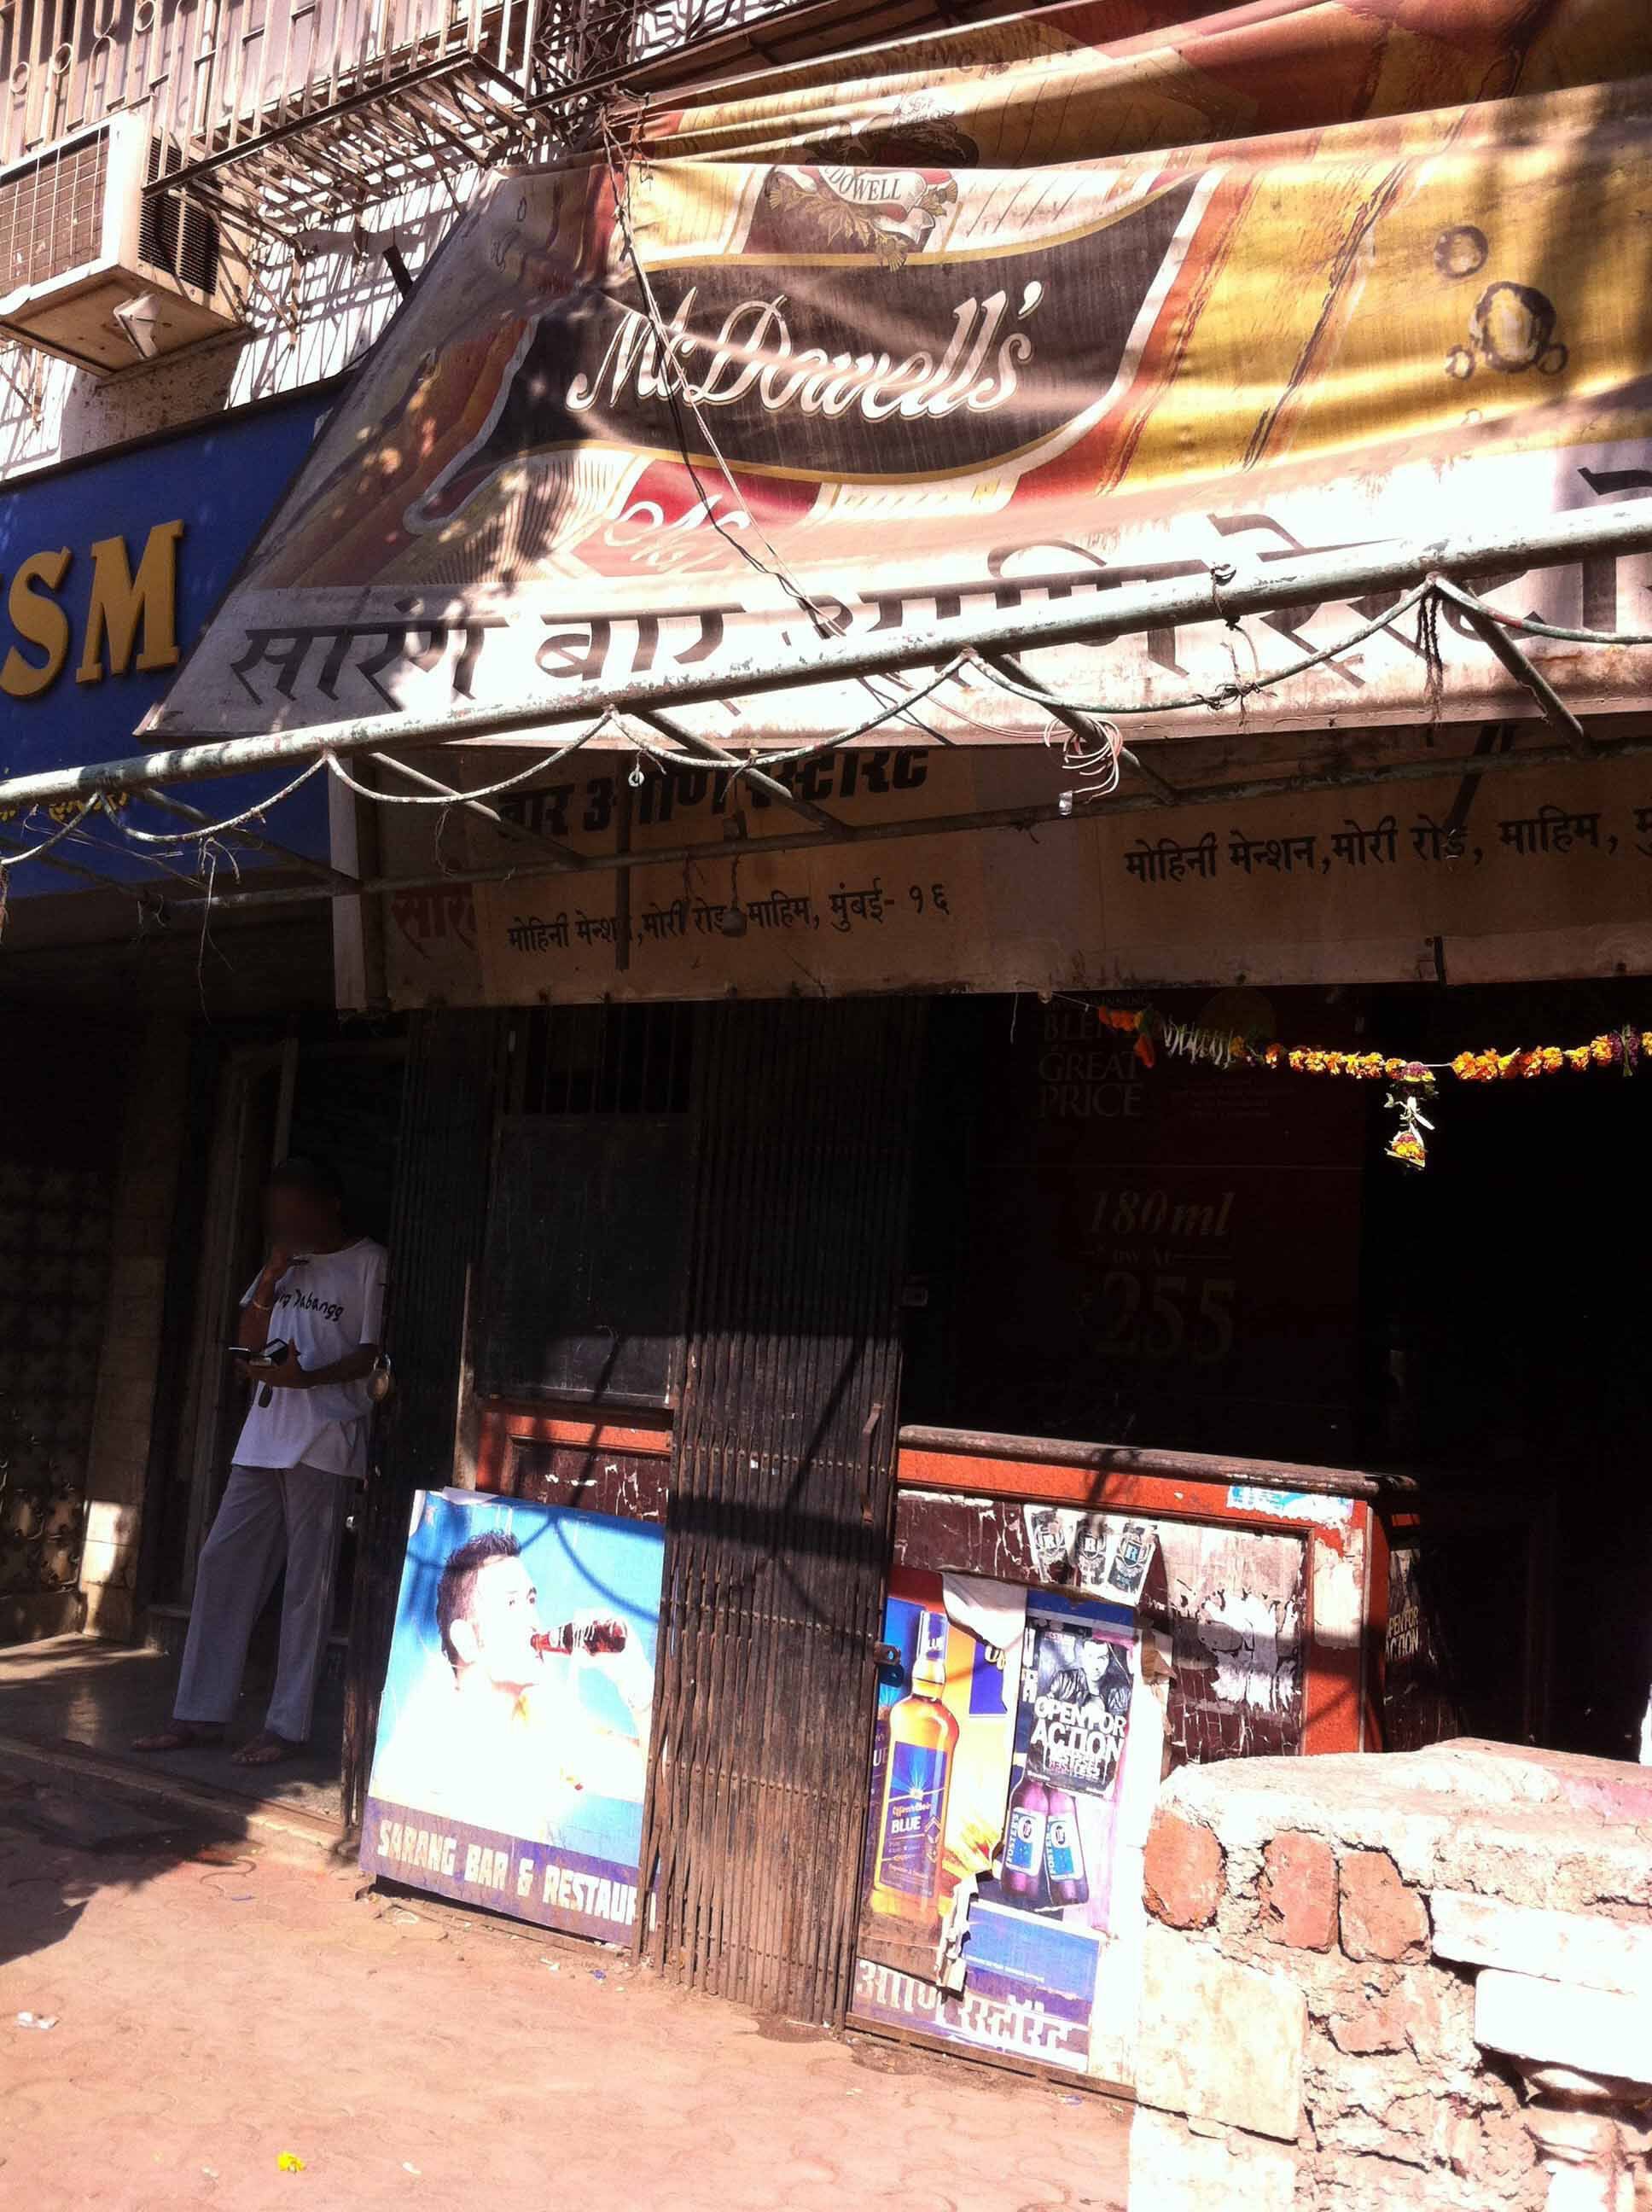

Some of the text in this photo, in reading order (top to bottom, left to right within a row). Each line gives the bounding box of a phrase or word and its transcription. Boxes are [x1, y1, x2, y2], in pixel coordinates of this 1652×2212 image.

[824, 168, 902, 201] DOWELL
[230, 599, 512, 716] सारंग
[534, 601, 747, 716] बार
[1124, 832, 1218, 882] मोहिनी
[1331, 816, 1398, 865] मोरी
[1498, 805, 1618, 856] माहिम,
[507, 911, 569, 952] मोहिनी
[642, 899, 689, 938] मोरी
[746, 889, 820, 930] माहिम,
[1038, 1051, 1142, 1083] GREAT
[1037, 1084, 1145, 1120] PRICE
[1034, 1695, 1087, 1730] OPEN
[1030, 1718, 1126, 1762] ACTION
[892, 1816, 922, 1834] BLUE
[377, 1819, 657, 1932] SARANG BAR & RESTAUR
